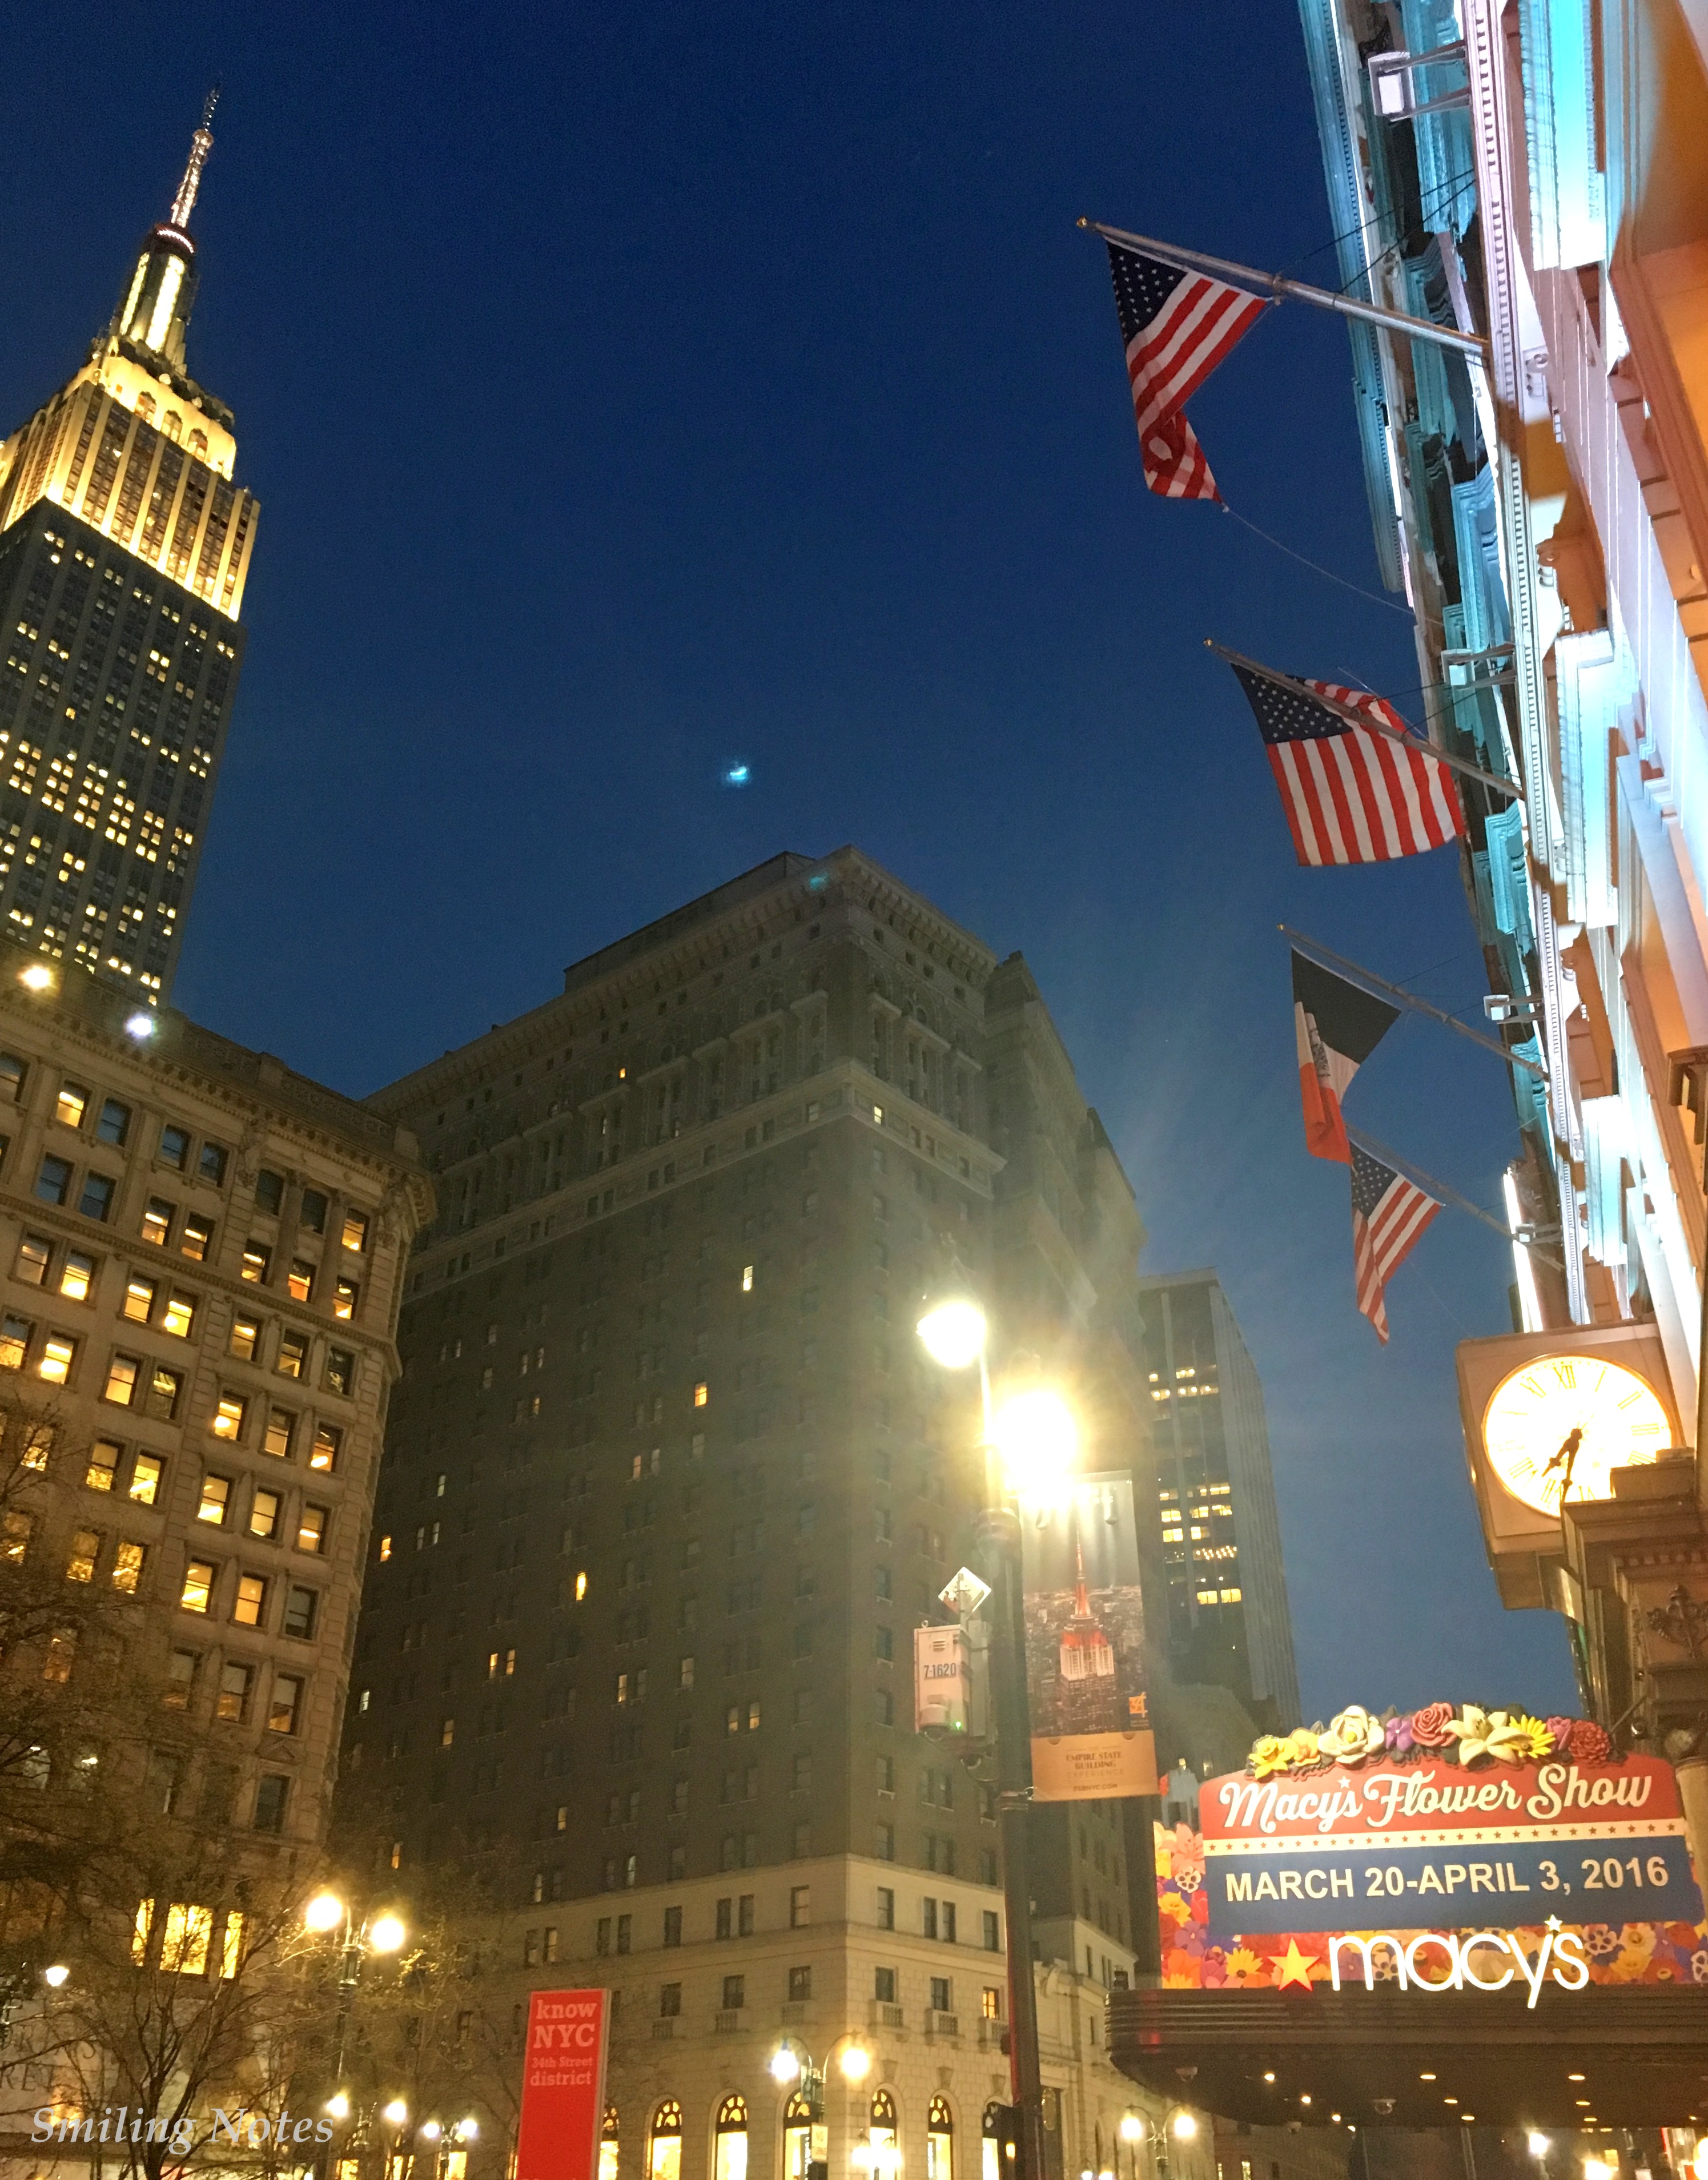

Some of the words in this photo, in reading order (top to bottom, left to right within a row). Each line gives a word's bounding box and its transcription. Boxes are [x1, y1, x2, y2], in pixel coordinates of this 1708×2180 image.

[1066, 1752, 1097, 1761] EMPIRE
[1099, 1751, 1123, 1759] STATE
[1075, 1760, 1116, 1769] BUILDING
[1067, 1768, 1124, 1778] EXPERIENCE
[1363, 1769, 1522, 1828] Flower
[1526, 1763, 1652, 1819] Show
[1225, 1868, 1354, 1902] MARCH
[1365, 1862, 1530, 1897] 20-APRIL
[1538, 1860, 1571, 1896] 3,
[1581, 1856, 1669, 1889] 2016
[536, 1999, 597, 2020] know
[533, 2023, 596, 2049] NYC
[531, 2057, 556, 2069] 34th
[558, 2056, 593, 2068] Street
[530, 2069, 592, 2086] district
